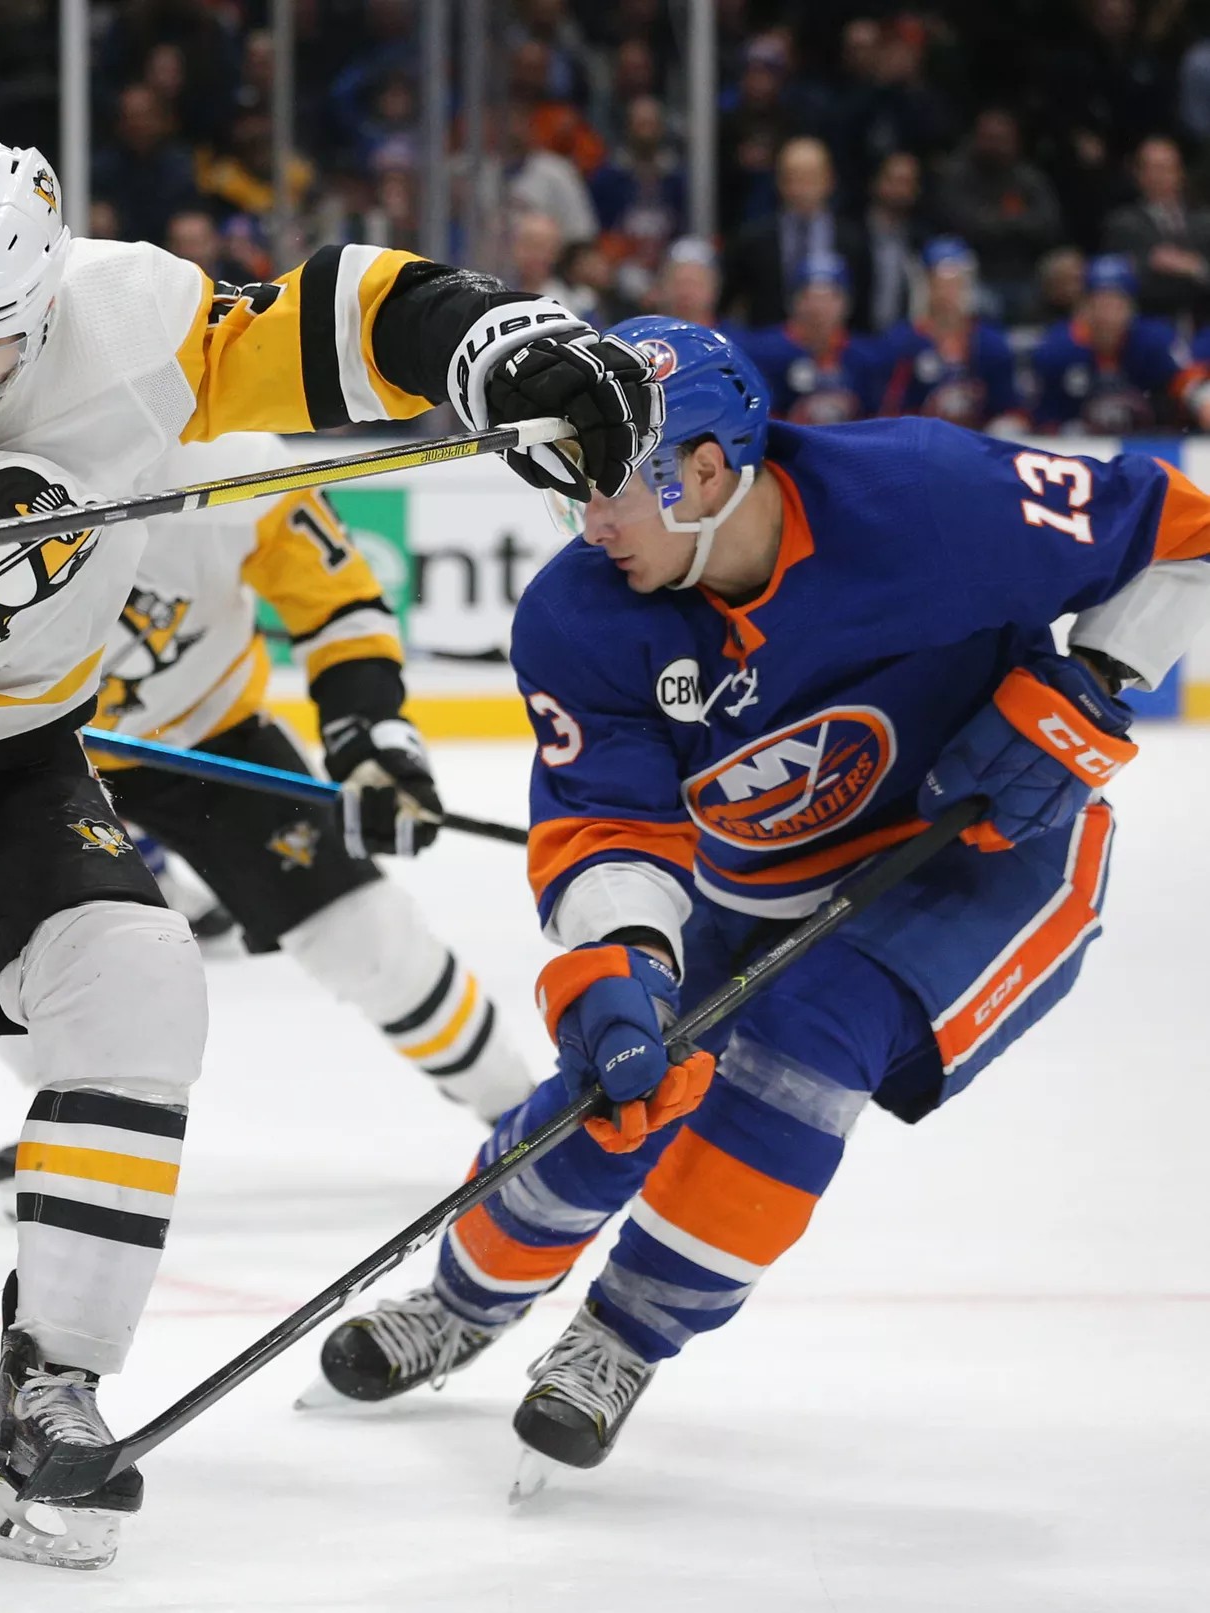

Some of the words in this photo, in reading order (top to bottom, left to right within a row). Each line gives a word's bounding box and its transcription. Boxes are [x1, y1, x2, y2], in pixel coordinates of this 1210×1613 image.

[1014, 452, 1094, 544] 13
[722, 751, 875, 838] ISLANDERS
[973, 964, 1023, 1026] CCM
[605, 1045, 647, 1072] CCM
